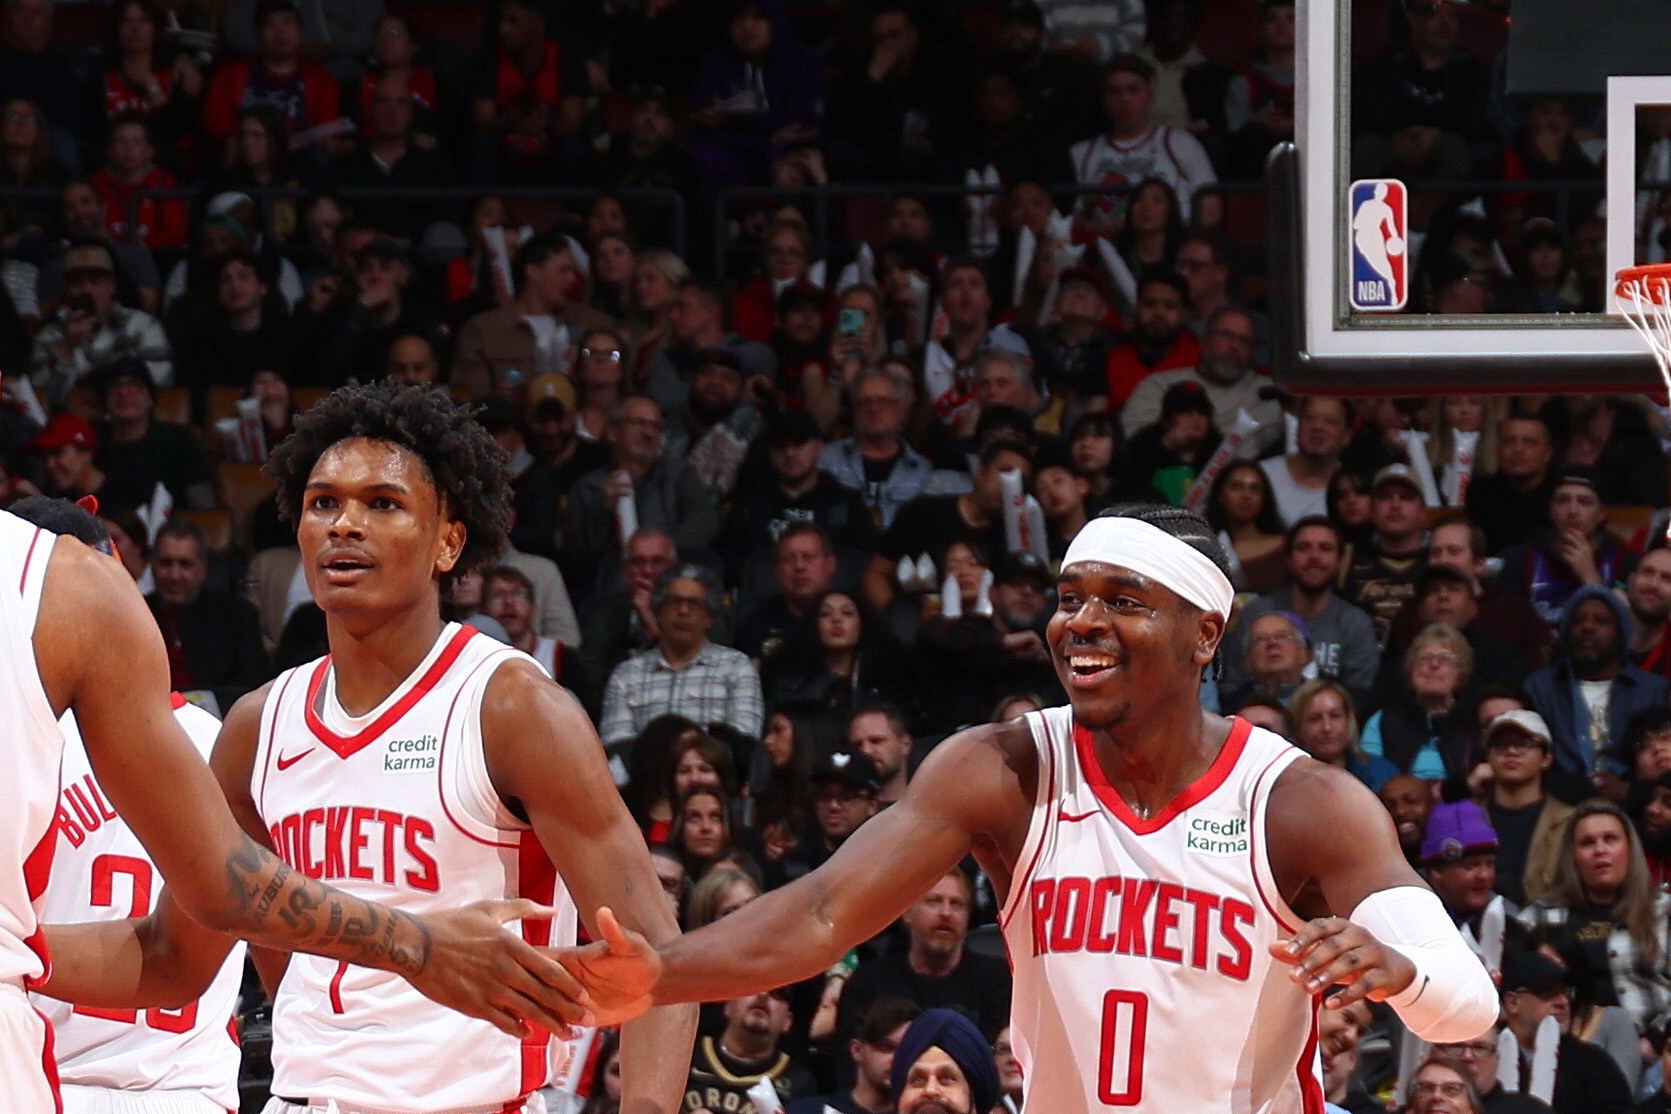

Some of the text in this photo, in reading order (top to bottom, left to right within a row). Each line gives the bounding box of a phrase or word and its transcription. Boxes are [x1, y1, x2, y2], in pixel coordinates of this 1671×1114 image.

[1358, 281, 1385, 300] NBA
[388, 735, 438, 752] credit
[384, 754, 435, 771] karma
[1191, 817, 1247, 836] credit
[1187, 835, 1248, 853] karma
[1032, 876, 1255, 981] ROCKETS
[1098, 989, 1148, 1106] 0
